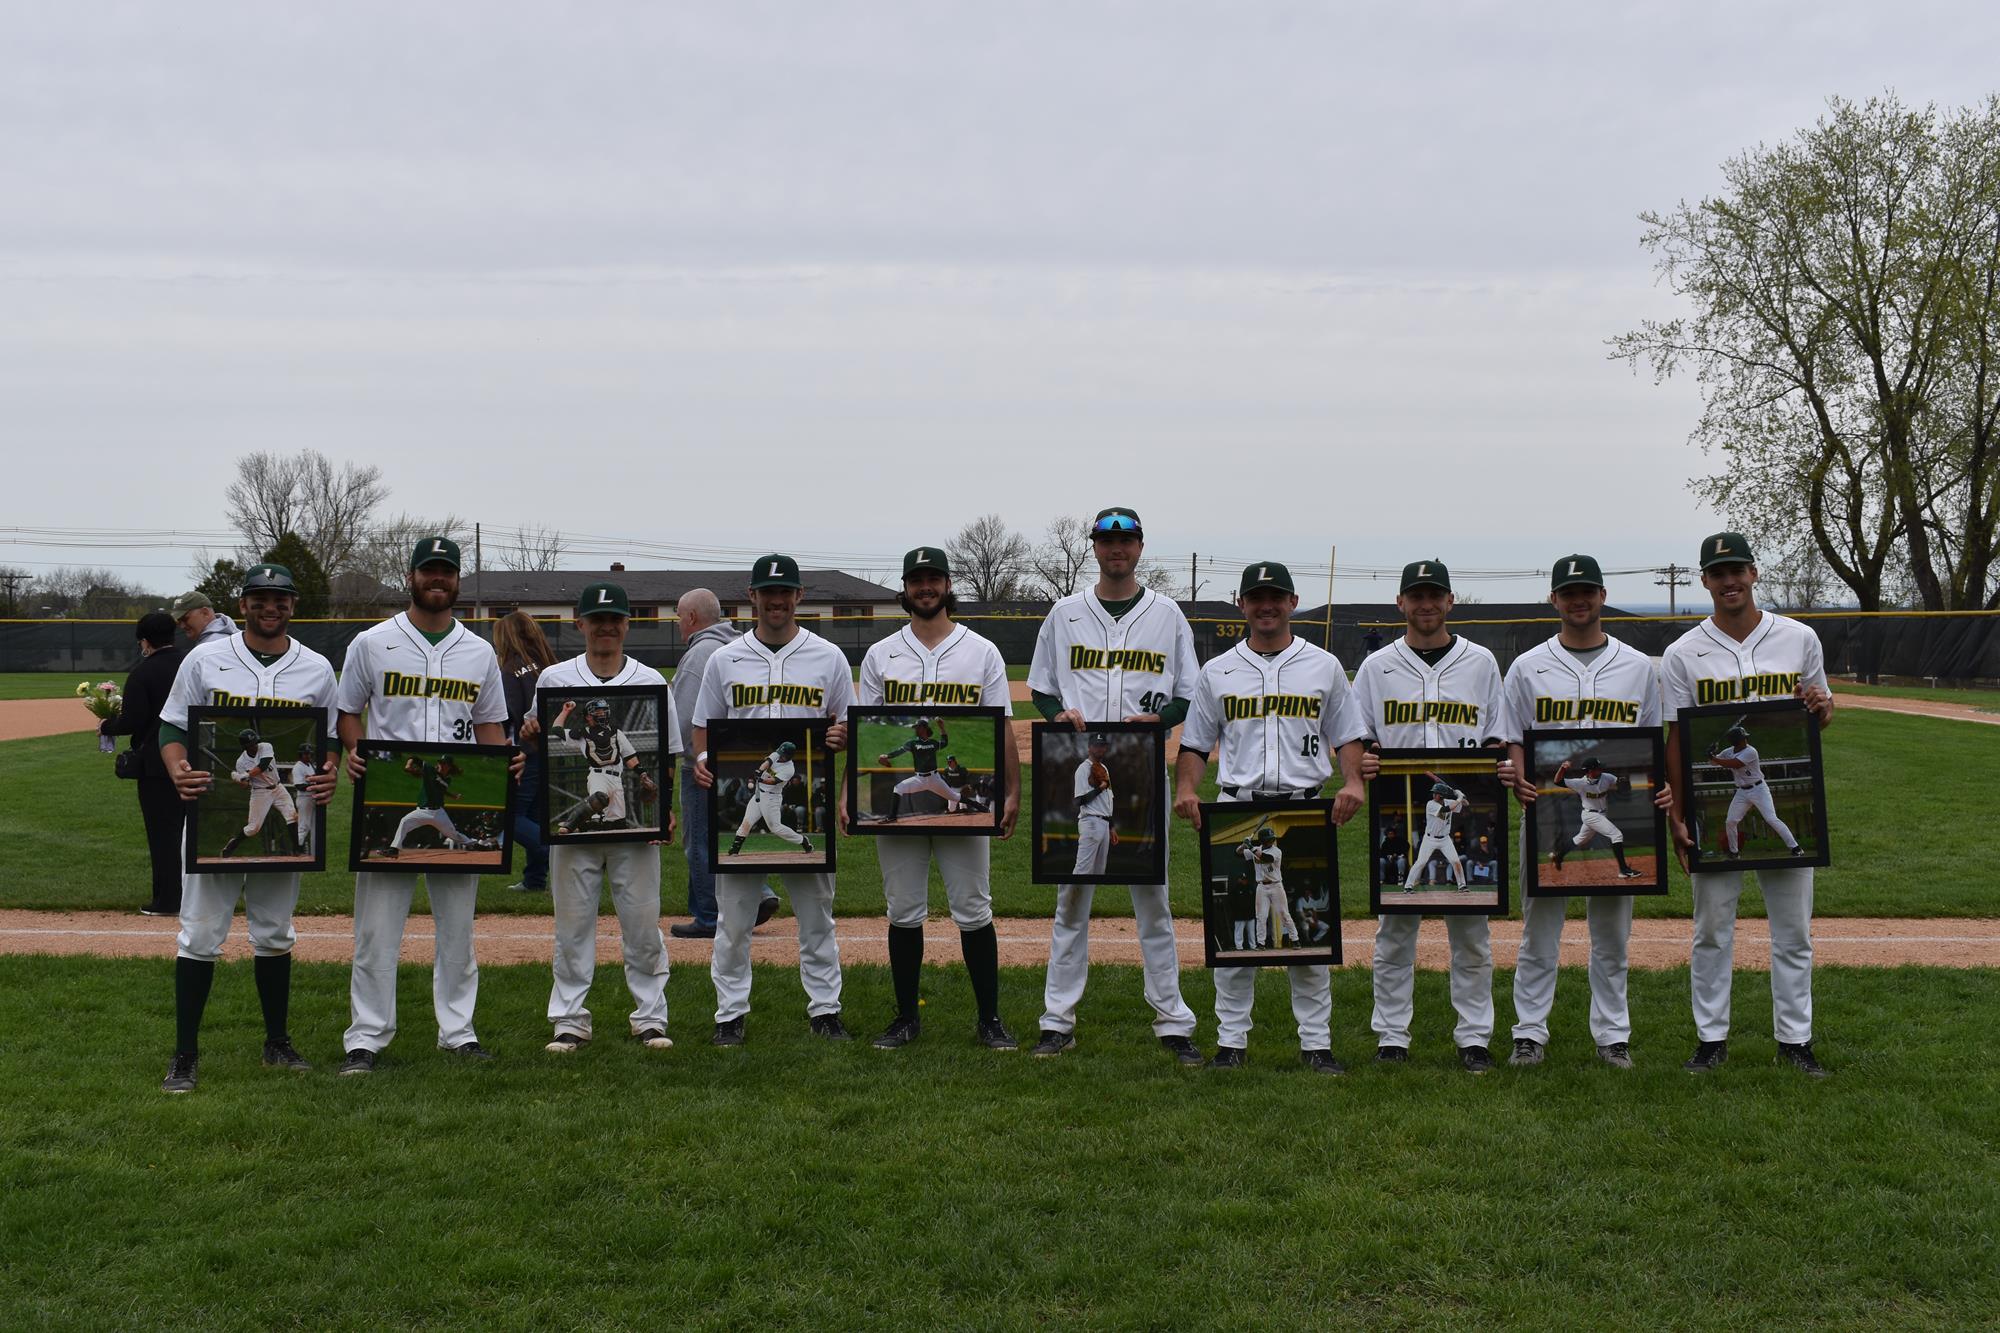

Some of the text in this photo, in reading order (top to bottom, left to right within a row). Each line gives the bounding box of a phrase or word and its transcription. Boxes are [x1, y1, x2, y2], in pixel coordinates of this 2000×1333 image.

[432, 540, 447, 554] L
[1715, 538, 1731, 554] L
[915, 550, 930, 564] L
[768, 562, 785, 577] L
[1258, 567, 1274, 581] L
[1418, 564, 1433, 577] L
[1568, 561, 1584, 576] L
[599, 589, 614, 603] L
[1216, 624, 1245, 638] 337
[1070, 645, 1166, 674] DOLPHINS
[383, 671, 481, 704] DOLPHINS
[732, 683, 825, 708] DOLPHINS
[884, 679, 982, 705] DOLPHINS
[1139, 691, 1163, 713] 40
[1223, 695, 1321, 722] DOLPHINS
[1537, 697, 1639, 724] DOLPHINS
[1384, 699, 1479, 727] DOLPHINS
[1300, 734, 1319, 757] 16
